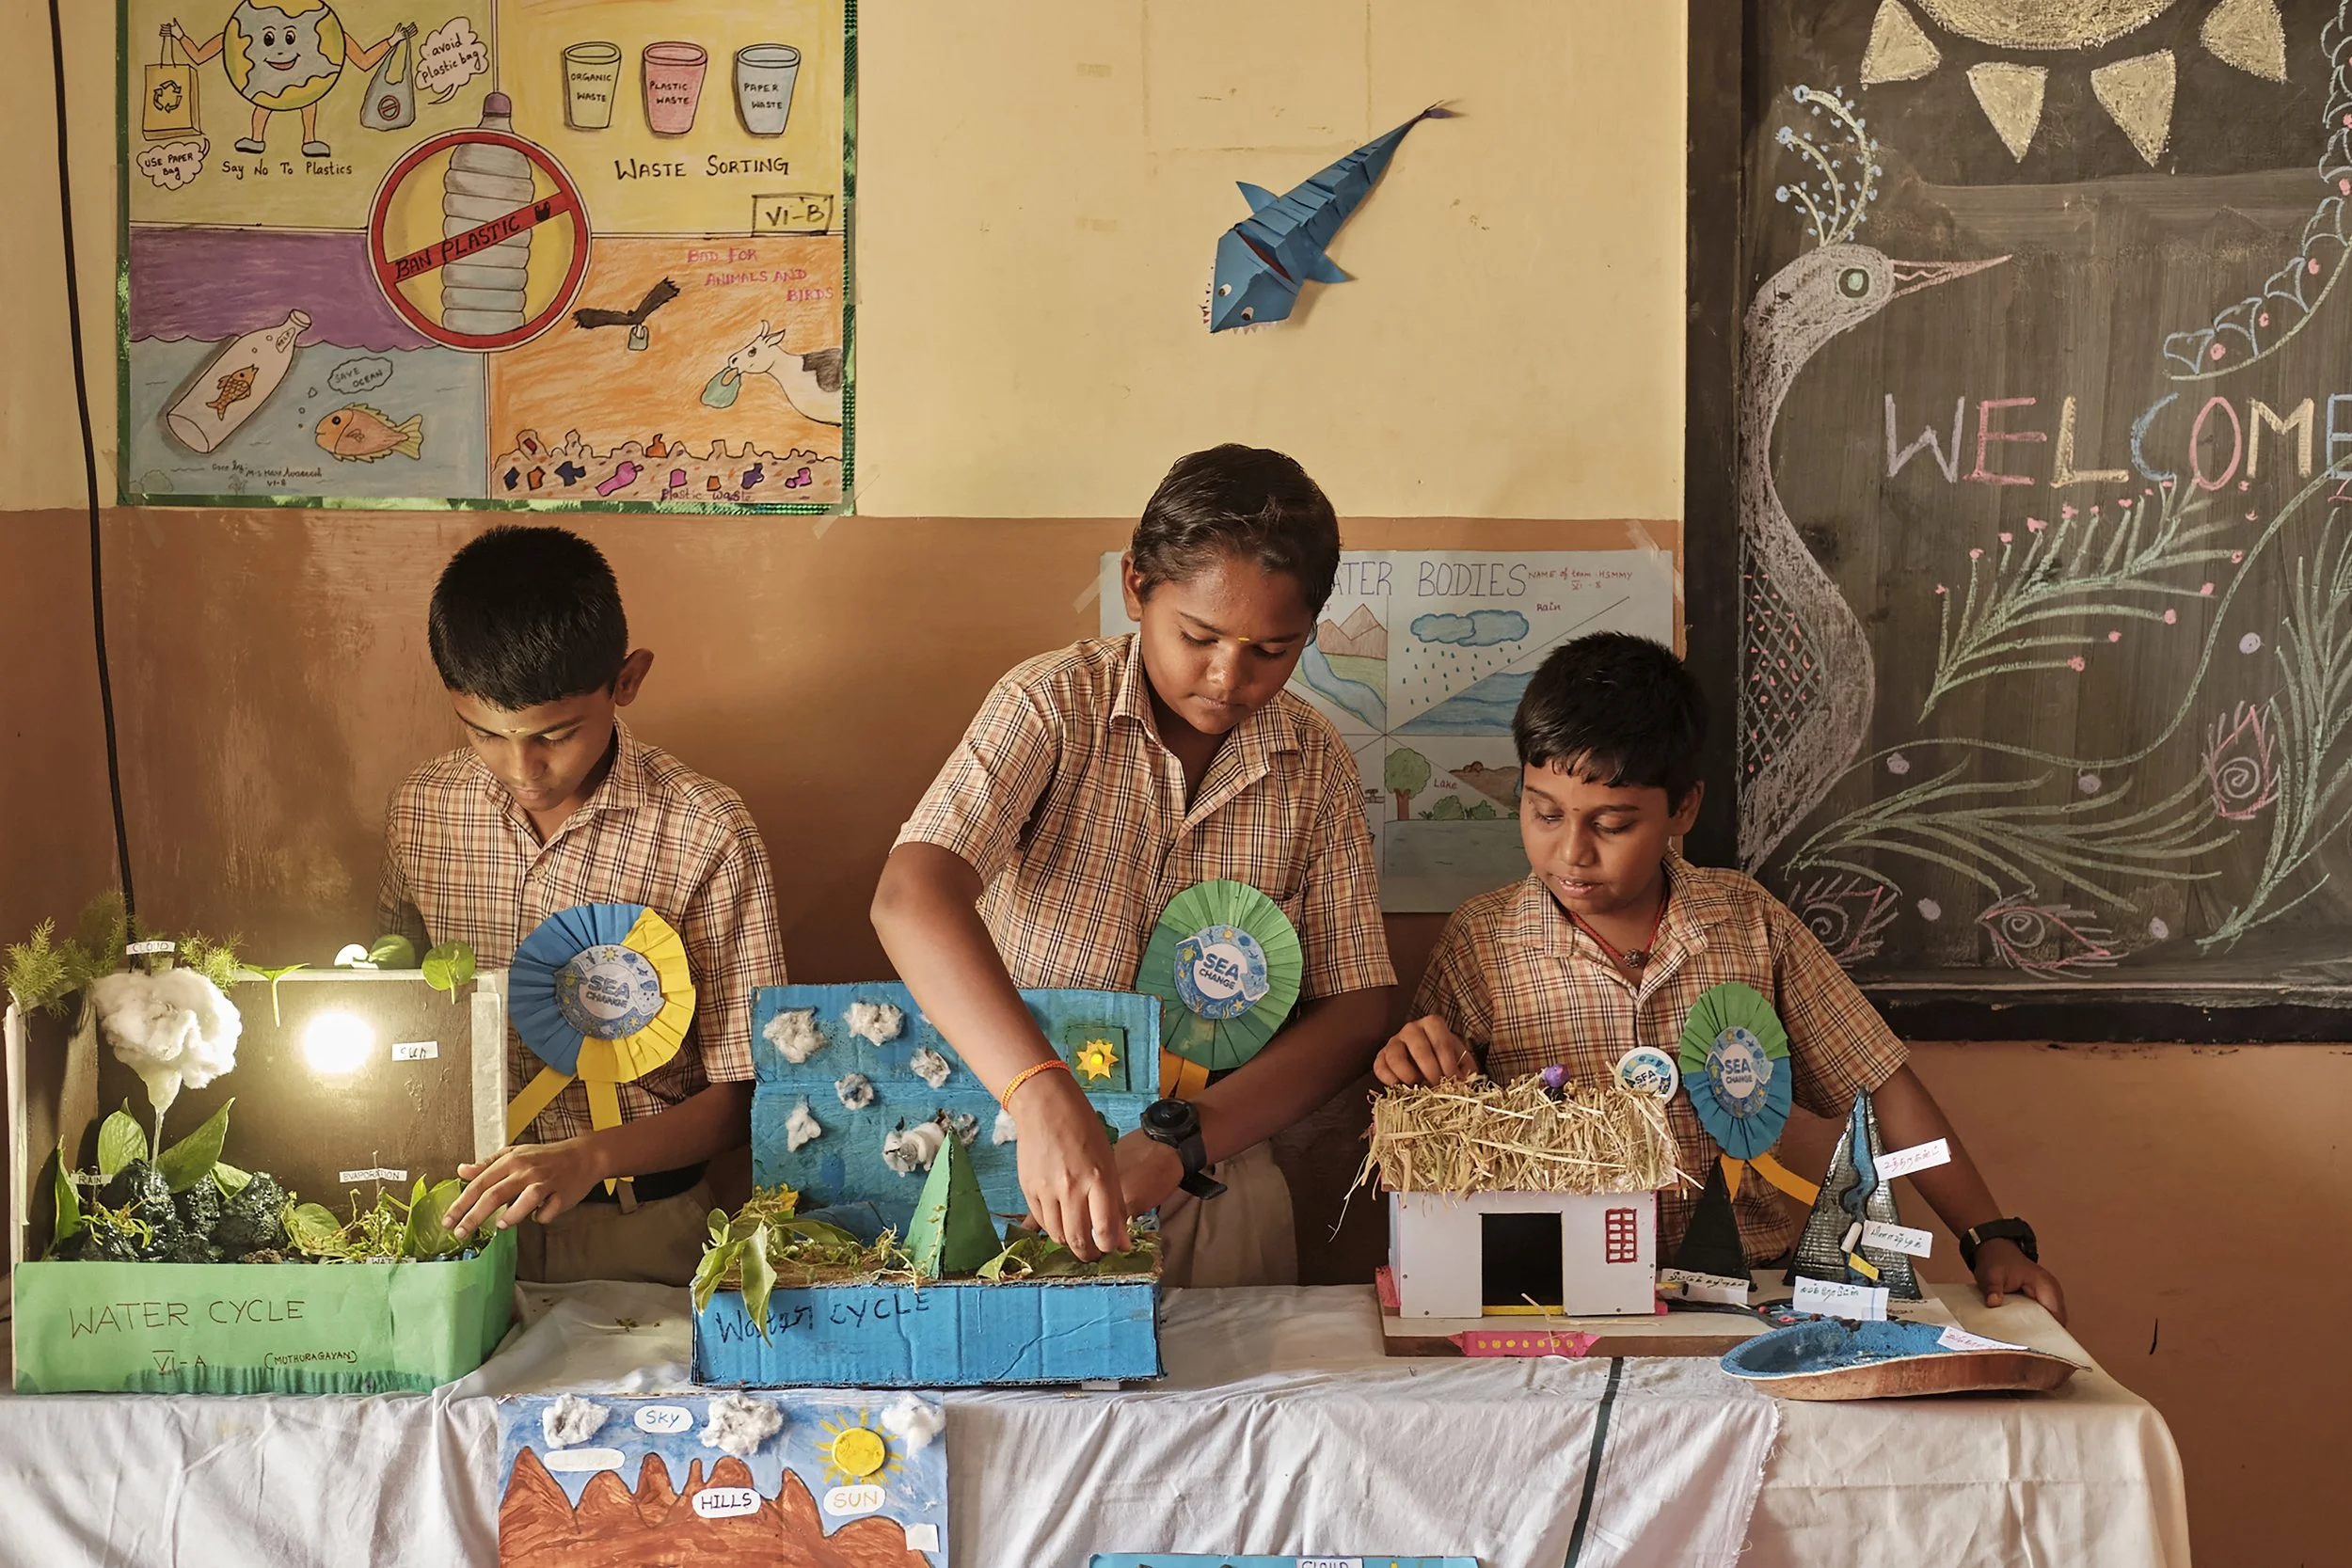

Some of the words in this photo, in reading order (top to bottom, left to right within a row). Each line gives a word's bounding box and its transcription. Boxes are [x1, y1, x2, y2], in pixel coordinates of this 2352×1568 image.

[432, 37, 461, 55] avoid
[421, 60, 458, 83] plastic
[460, 48, 484, 71] bag
[570, 71, 612, 83] ORGANIC
[649, 80, 688, 91] PLASTIC
[743, 83, 779, 92] PAPER
[577, 92, 607, 103] WASTE
[656, 97, 690, 105] WASTE
[752, 101, 783, 110] WASTE
[145, 157, 163, 167] USE
[167, 152, 194, 164] PAPER
[222, 162, 245, 180] Say
[254, 159, 269, 176] No
[279, 162, 294, 175] To
[306, 162, 353, 176] Plastics
[613, 158, 687, 181] WASTE
[706, 155, 789, 177] SORTING
[395, 249, 432, 278] BAN
[441, 216, 520, 263] PLASTIC
[688, 249, 718, 262] BAD
[728, 247, 757, 263] FOR
[705, 271, 768, 286] ANIMALS
[772, 269, 807, 282] AND
[787, 288, 834, 301] BIRDS
[335, 368, 359, 383] SAVE
[353, 370, 383, 388] OCEAN
[1885, 392, 2352, 491] WELCOME
[660, 488, 702, 501] Plastic
[1332, 562, 1392, 595] ATER
[1418, 561, 1528, 596] BODIES
[1529, 570, 1556, 579] NAME
[1560, 567, 1568, 580] of
[1434, 778, 1457, 790] Lake
[132, 942, 169, 952] CLOUD
[1203, 953, 1240, 981] SEA
[588, 975, 629, 999] SEA
[1199, 969, 1236, 990] CHANGE
[1725, 1058, 1751, 1074] SEA
[78, 1176, 103, 1184] RAIN
[342, 1169, 400, 1180] EVAPORATION
[830, 1292, 930, 1328] CYCLE
[70, 1303, 188, 1338] WATER
[209, 1299, 305, 1323] CYCLE
[645, 1409, 679, 1428] SKY
[701, 1493, 753, 1512] HILLS
[834, 1491, 879, 1509] SUN
